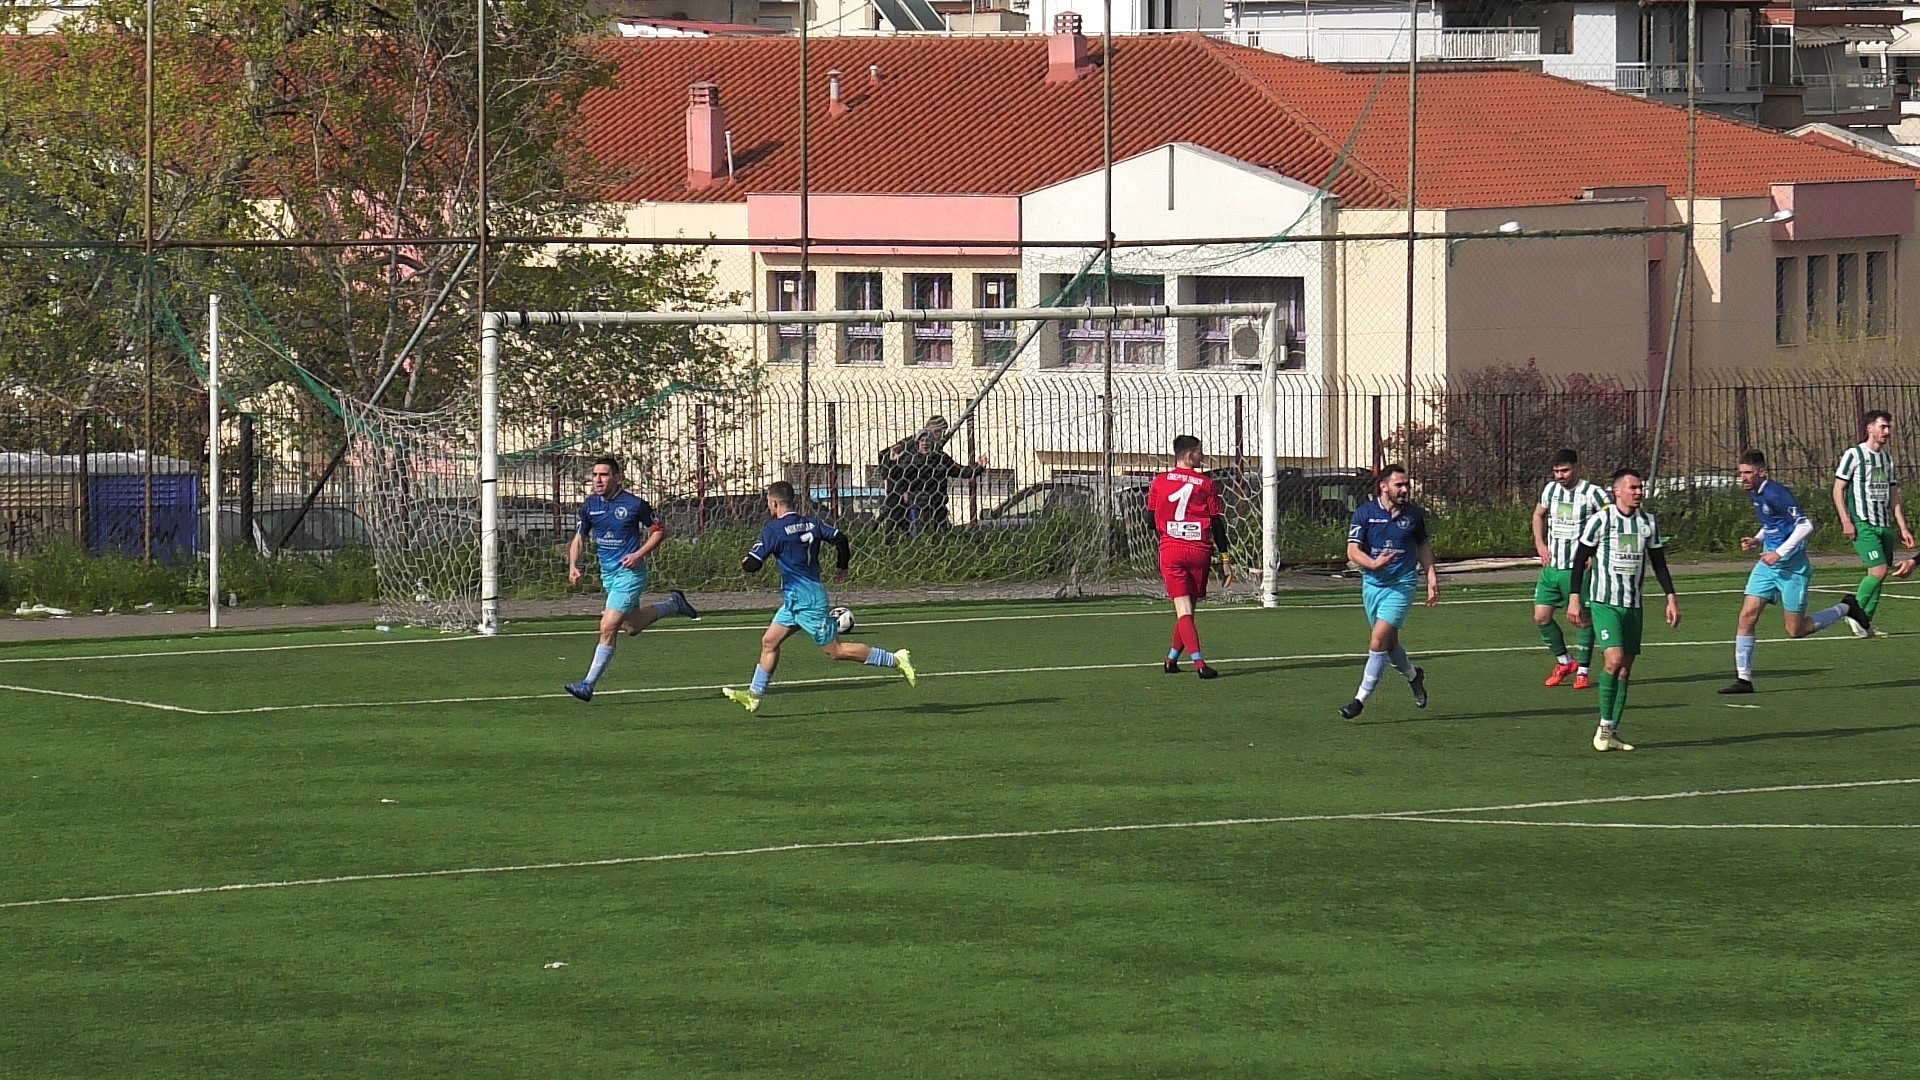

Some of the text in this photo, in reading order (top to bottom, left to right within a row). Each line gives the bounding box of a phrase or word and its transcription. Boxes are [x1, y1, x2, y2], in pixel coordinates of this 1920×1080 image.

[1168, 483, 1193, 521] 1
[800, 532, 814, 566] 7
[1868, 550, 1879, 561] 10
[1601, 629, 1609, 640] 5
